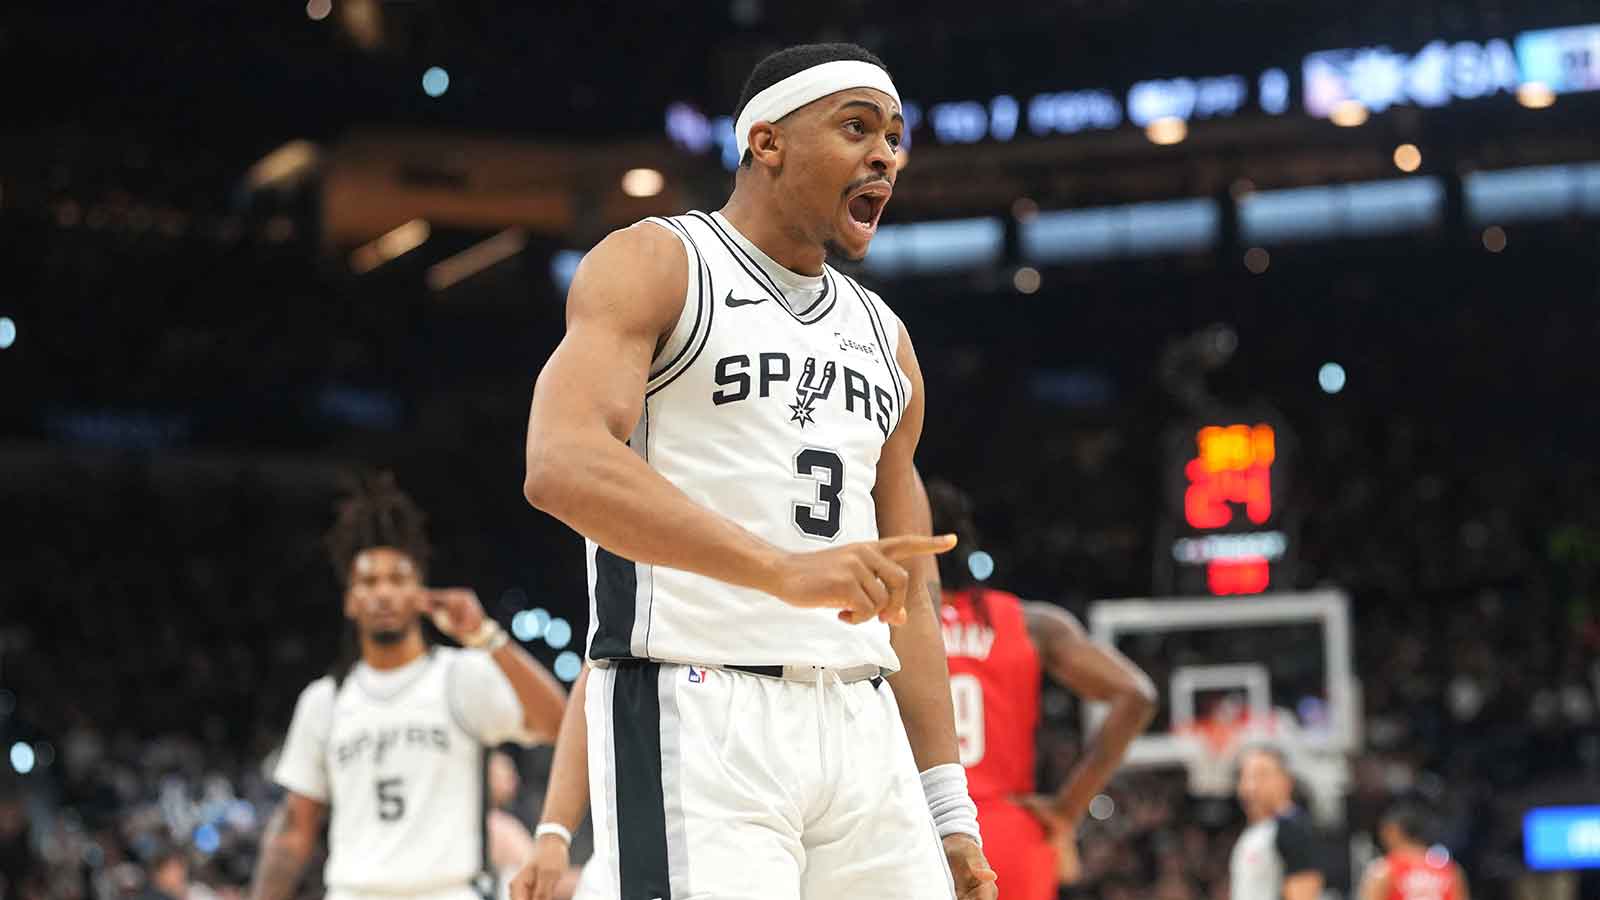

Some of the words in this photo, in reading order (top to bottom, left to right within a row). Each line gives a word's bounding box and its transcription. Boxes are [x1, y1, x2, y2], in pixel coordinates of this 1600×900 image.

[712, 352, 893, 440] SPURS
[792, 445, 845, 542] 3
[376, 776, 405, 823] 5
